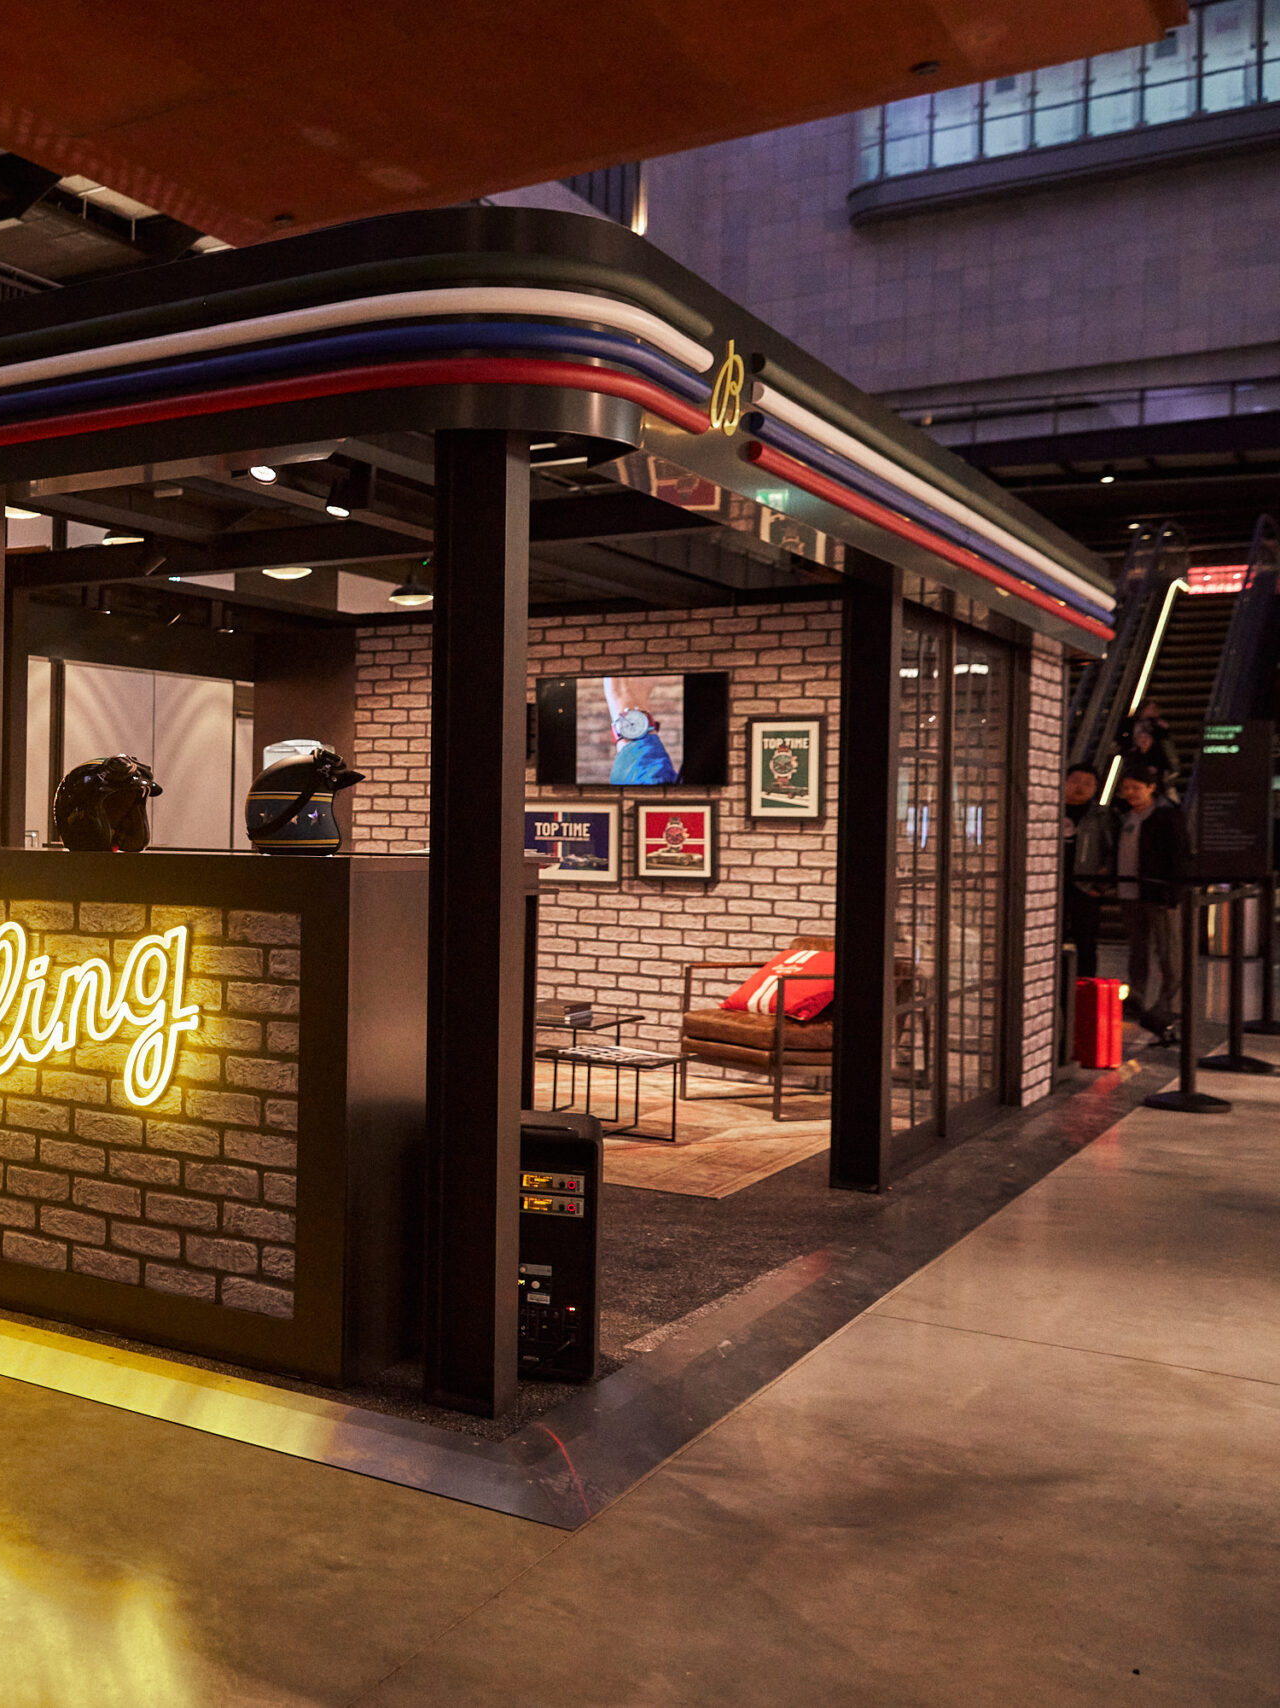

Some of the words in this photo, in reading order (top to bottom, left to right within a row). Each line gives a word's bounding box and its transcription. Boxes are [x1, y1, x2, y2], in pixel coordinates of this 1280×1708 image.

[762, 737, 783, 750] TOP
[784, 737, 810, 750] TIME
[534, 821, 559, 837] TOP
[560, 822, 591, 837] TIME
